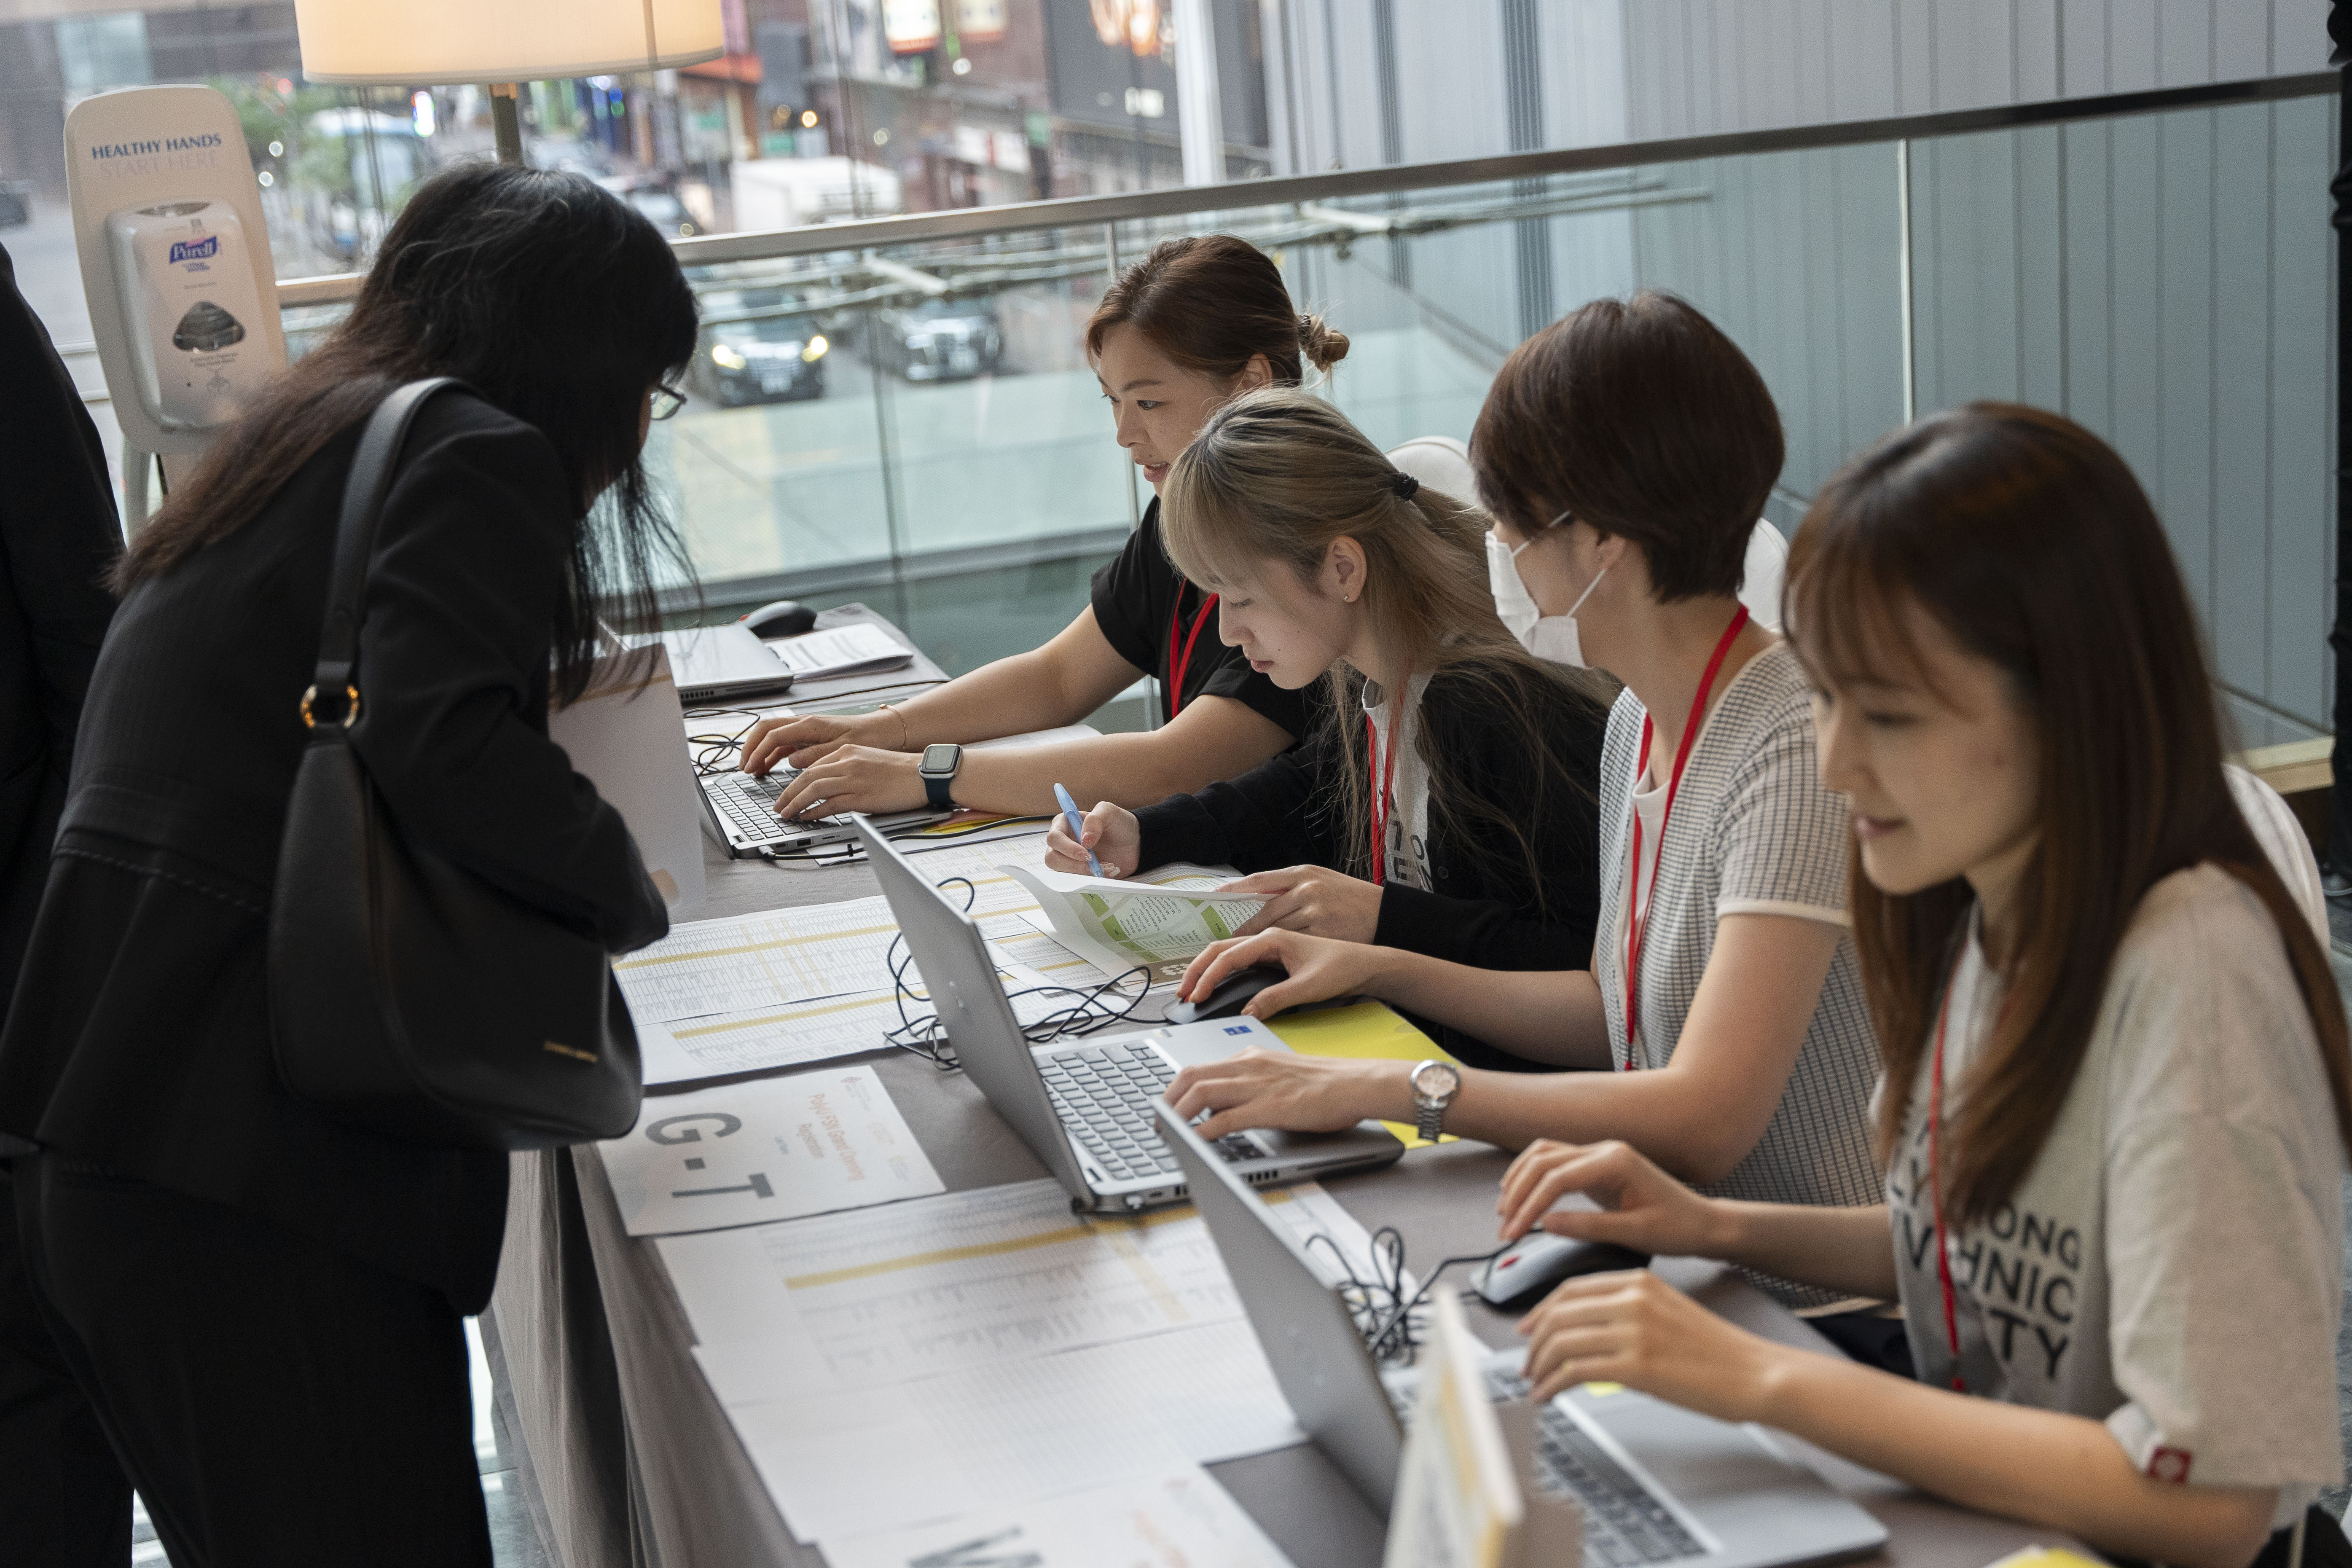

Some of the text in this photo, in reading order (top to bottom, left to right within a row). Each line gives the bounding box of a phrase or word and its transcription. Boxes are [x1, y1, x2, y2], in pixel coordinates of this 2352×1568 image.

[91, 133, 222, 160] HEALTHY HANDS
[99, 149, 217, 180] START HERE
[1157, 899, 1166, 910] Monica
[809, 1094, 829, 1114] PolyU
[644, 1112, 775, 1199] G-T
